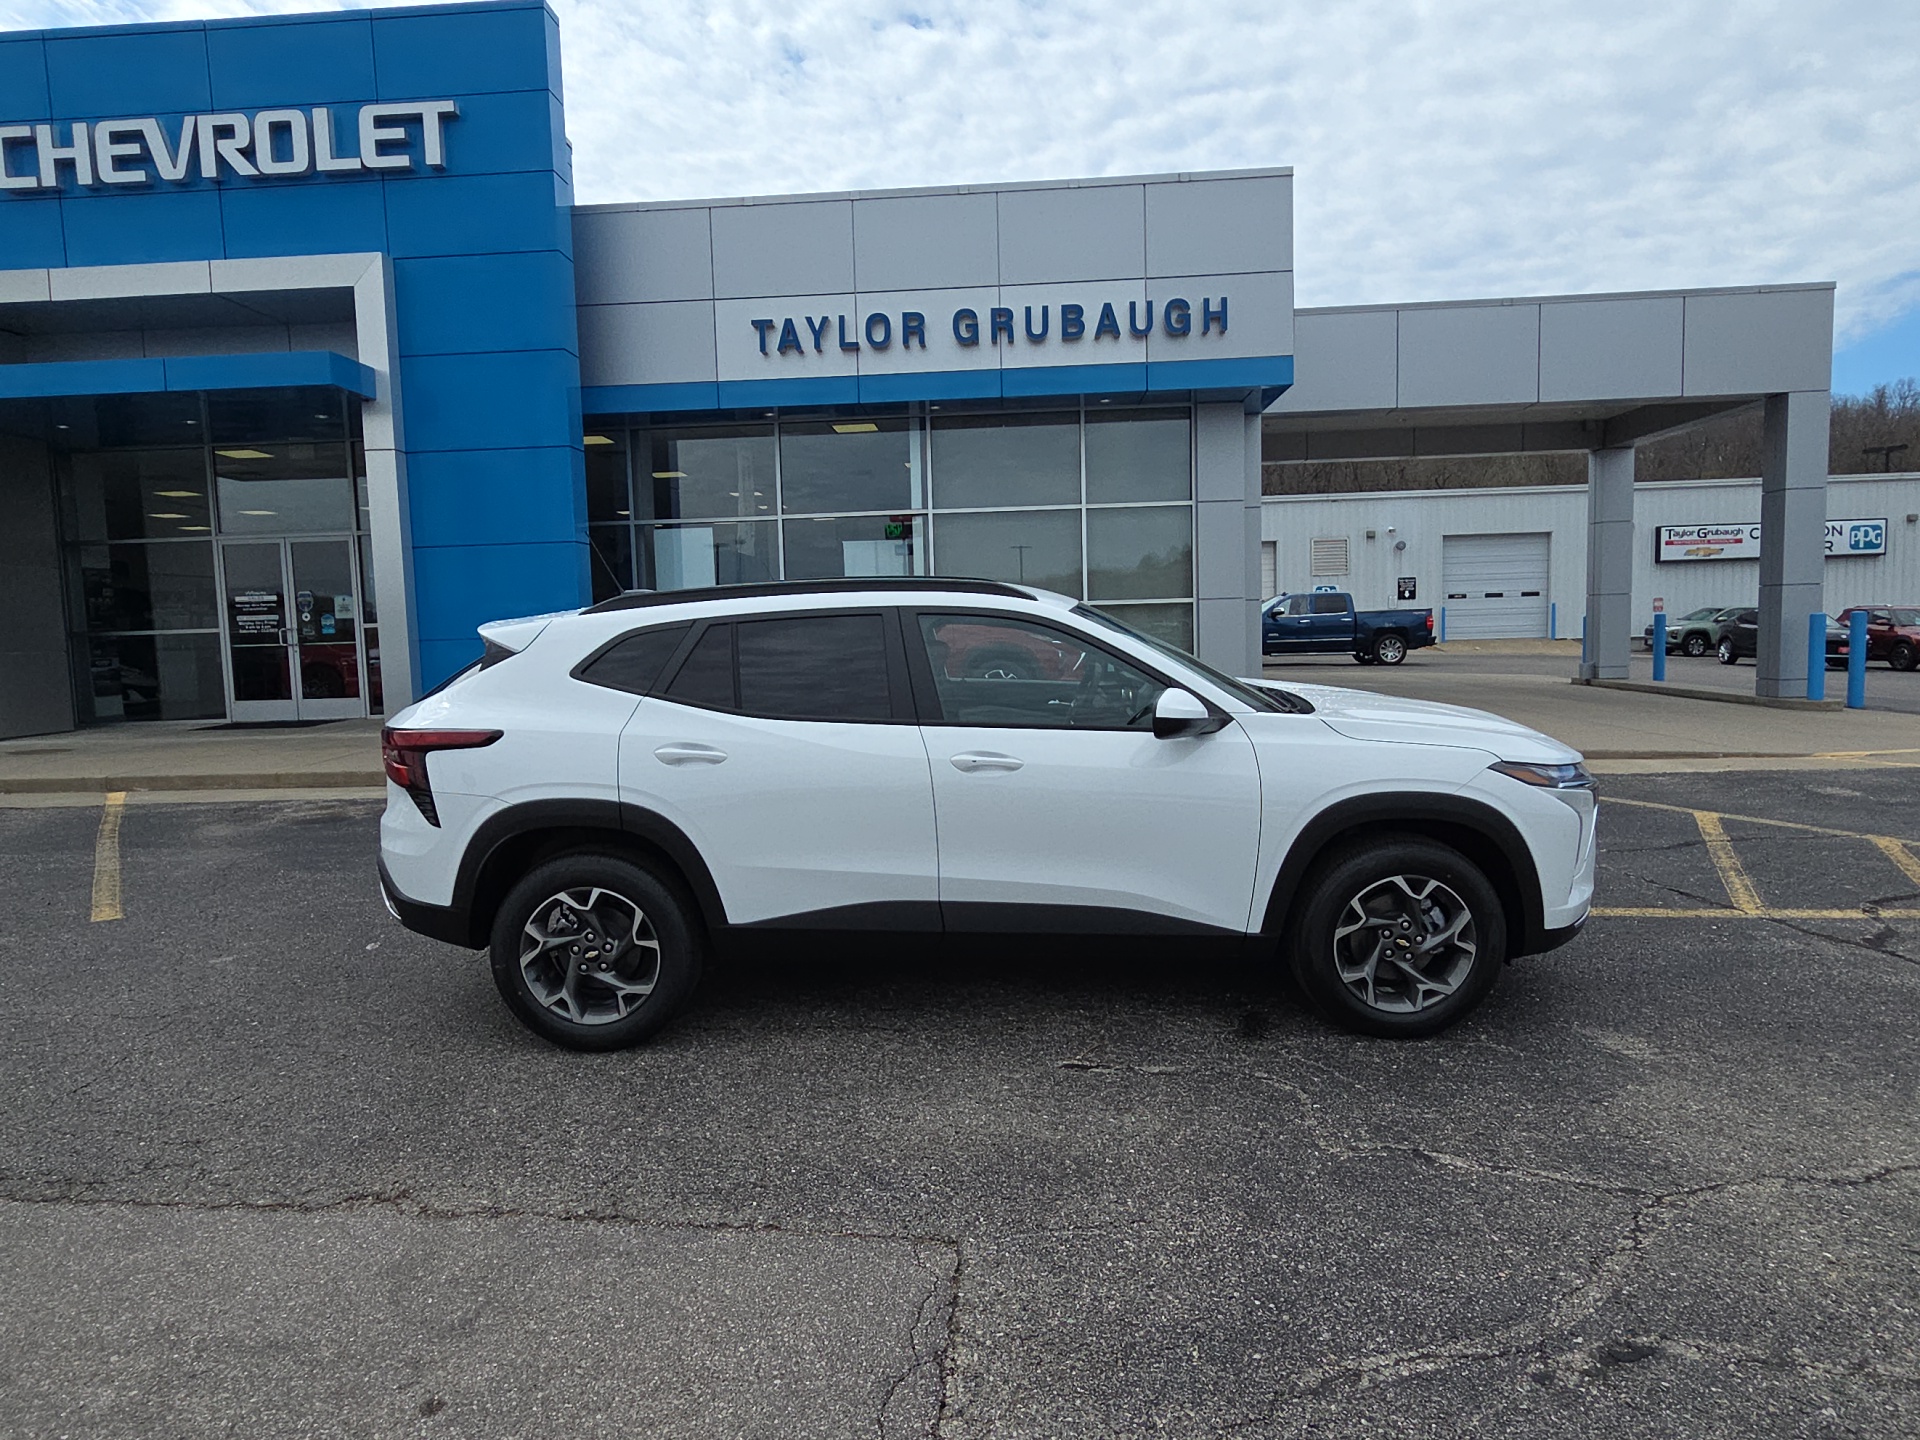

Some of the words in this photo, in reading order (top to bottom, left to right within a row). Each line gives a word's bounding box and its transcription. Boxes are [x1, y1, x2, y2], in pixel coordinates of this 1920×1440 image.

[0, 100, 458, 189] CHEVROLET
[750, 310, 927, 355] TAYLOR
[952, 296, 1229, 346] GRUBAUGH
[1665, 528, 1695, 540] Taylor
[1697, 527, 1744, 539] Grubaugh
